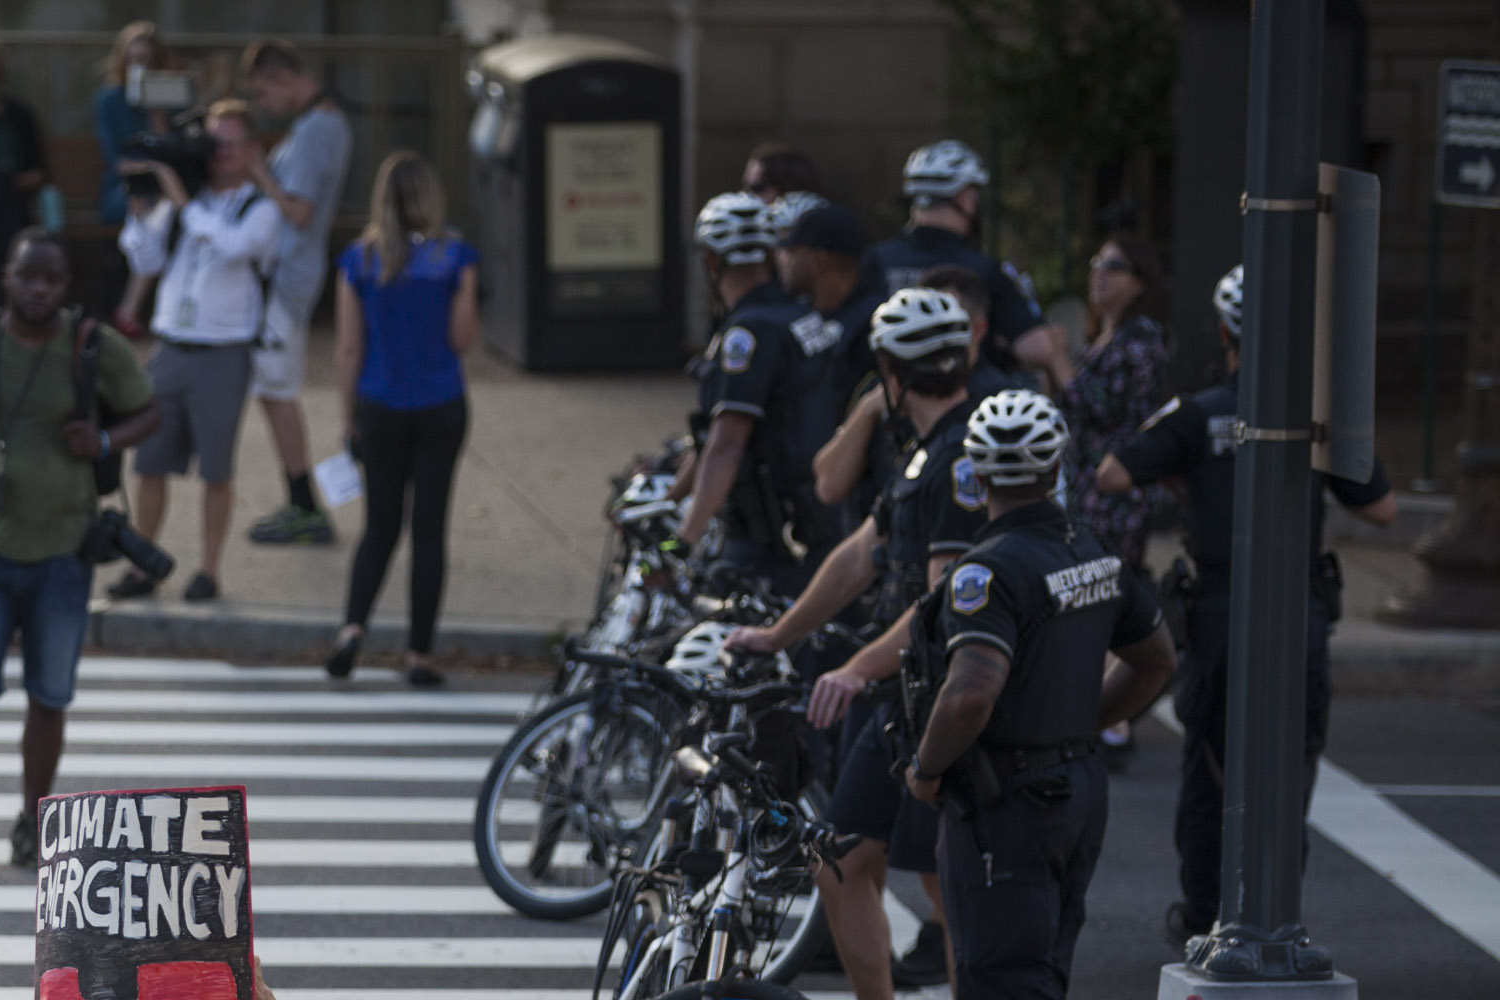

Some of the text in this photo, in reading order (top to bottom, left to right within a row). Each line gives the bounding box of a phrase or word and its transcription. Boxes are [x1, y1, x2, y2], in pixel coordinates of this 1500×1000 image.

[1058, 577, 1120, 612] POLICE
[41, 796, 231, 861] CLIMATE
[36, 857, 246, 940] EMERGENCY
